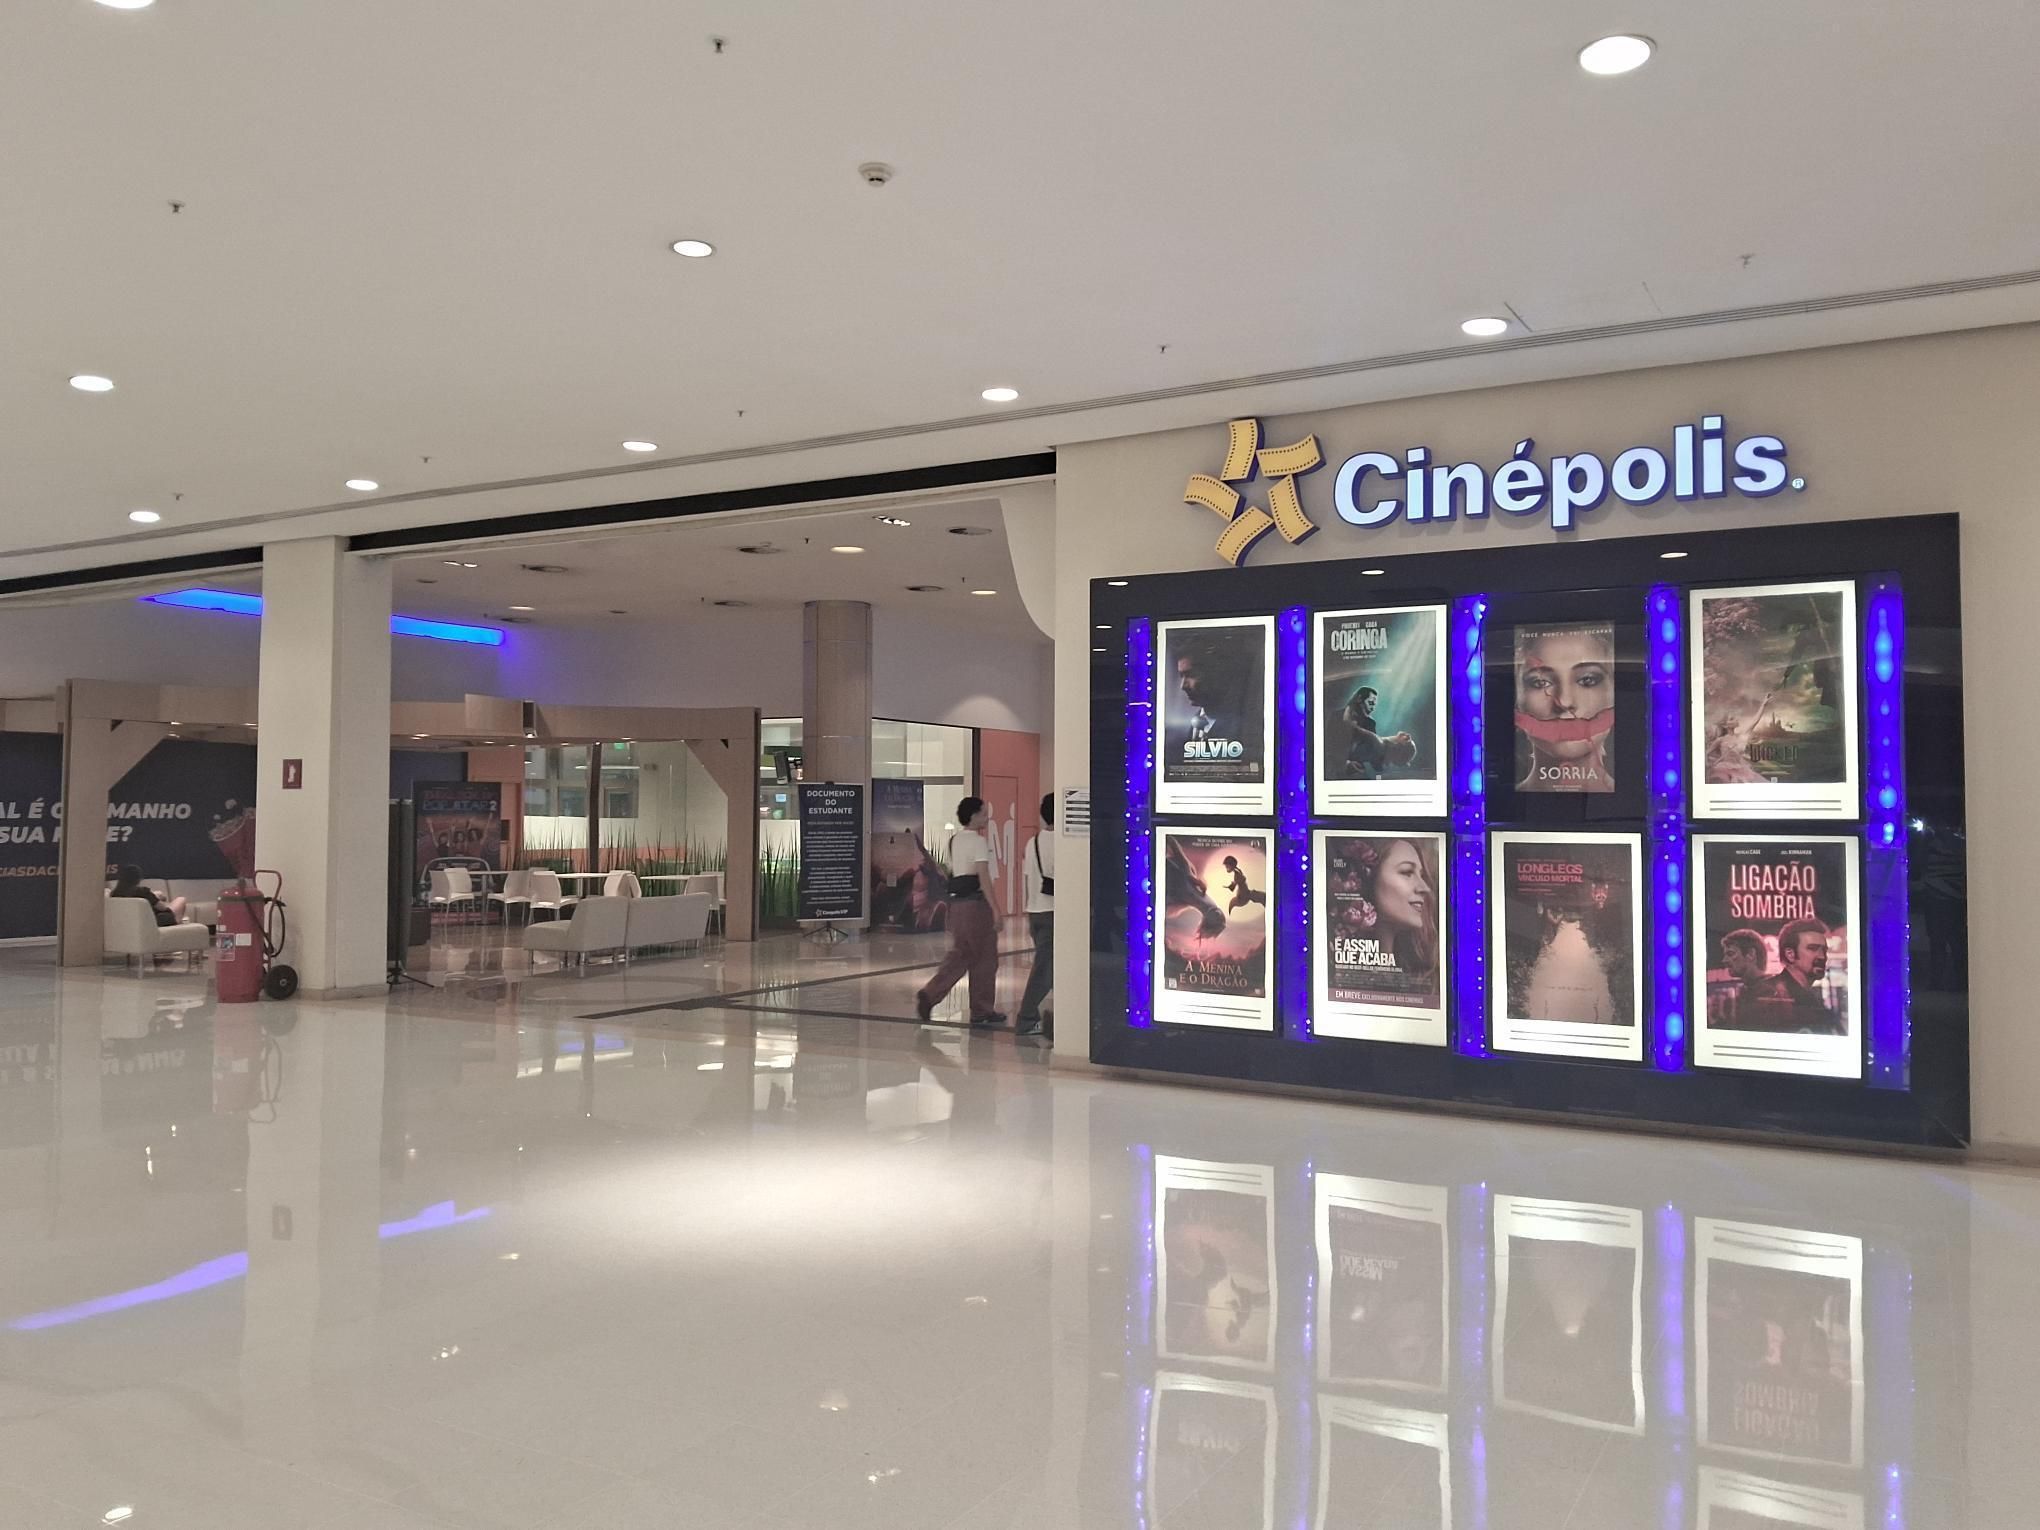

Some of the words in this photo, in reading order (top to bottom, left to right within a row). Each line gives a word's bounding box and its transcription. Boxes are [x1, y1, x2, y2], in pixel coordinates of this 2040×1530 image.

[1333, 415, 1789, 531] Cinépolis
[1331, 628, 1388, 651] CORINGA
[1184, 741, 1243, 758] SILVIO
[1540, 767, 1598, 780] SORRIA
[28, 797, 45, 819] É
[1517, 863, 1583, 874] LONGLEGS
[1731, 861, 1815, 895] LIGAÇÃO
[1731, 894, 1815, 919] SOMBRIA
[1335, 936, 1342, 951] É
[1343, 939, 1379, 953] ASSIM
[1335, 951, 1357, 964] QUE
[1358, 953, 1396, 967] ACABA
[1185, 961, 1193, 972] A
[1200, 961, 1242, 975] MENINA
[1180, 973, 1186, 983] E
[1189, 974, 1197, 984] O
[1336, 990, 1343, 998] EM
[1345, 991, 1361, 1000] BREVE
